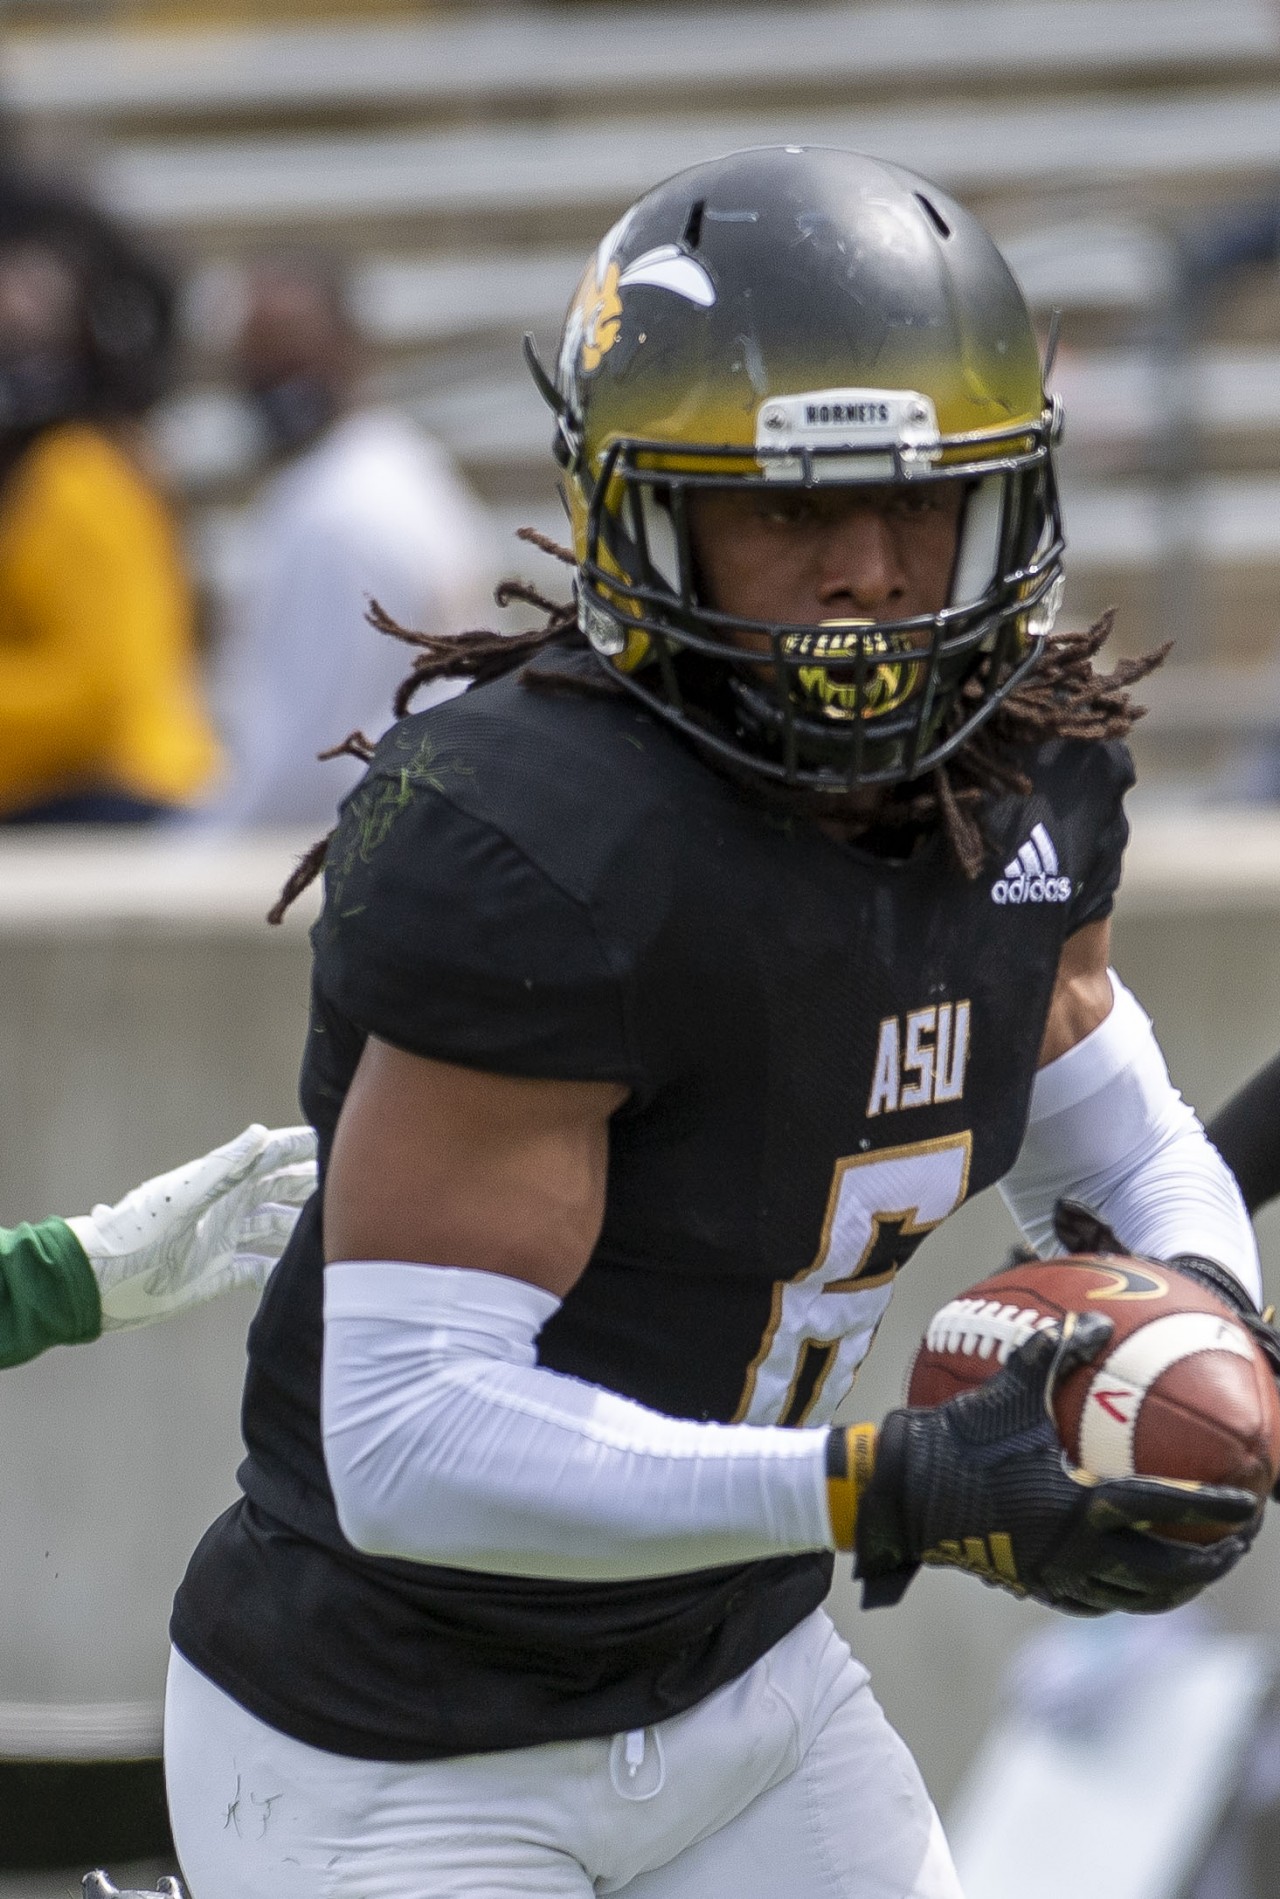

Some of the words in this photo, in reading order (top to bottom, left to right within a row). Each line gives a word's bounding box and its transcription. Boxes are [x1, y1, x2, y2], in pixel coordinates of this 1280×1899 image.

[806, 403, 890, 425] HORNETS
[991, 871, 1072, 905] adidas
[866, 999, 971, 1118] ASU
[731, 1130, 973, 1427] 6
